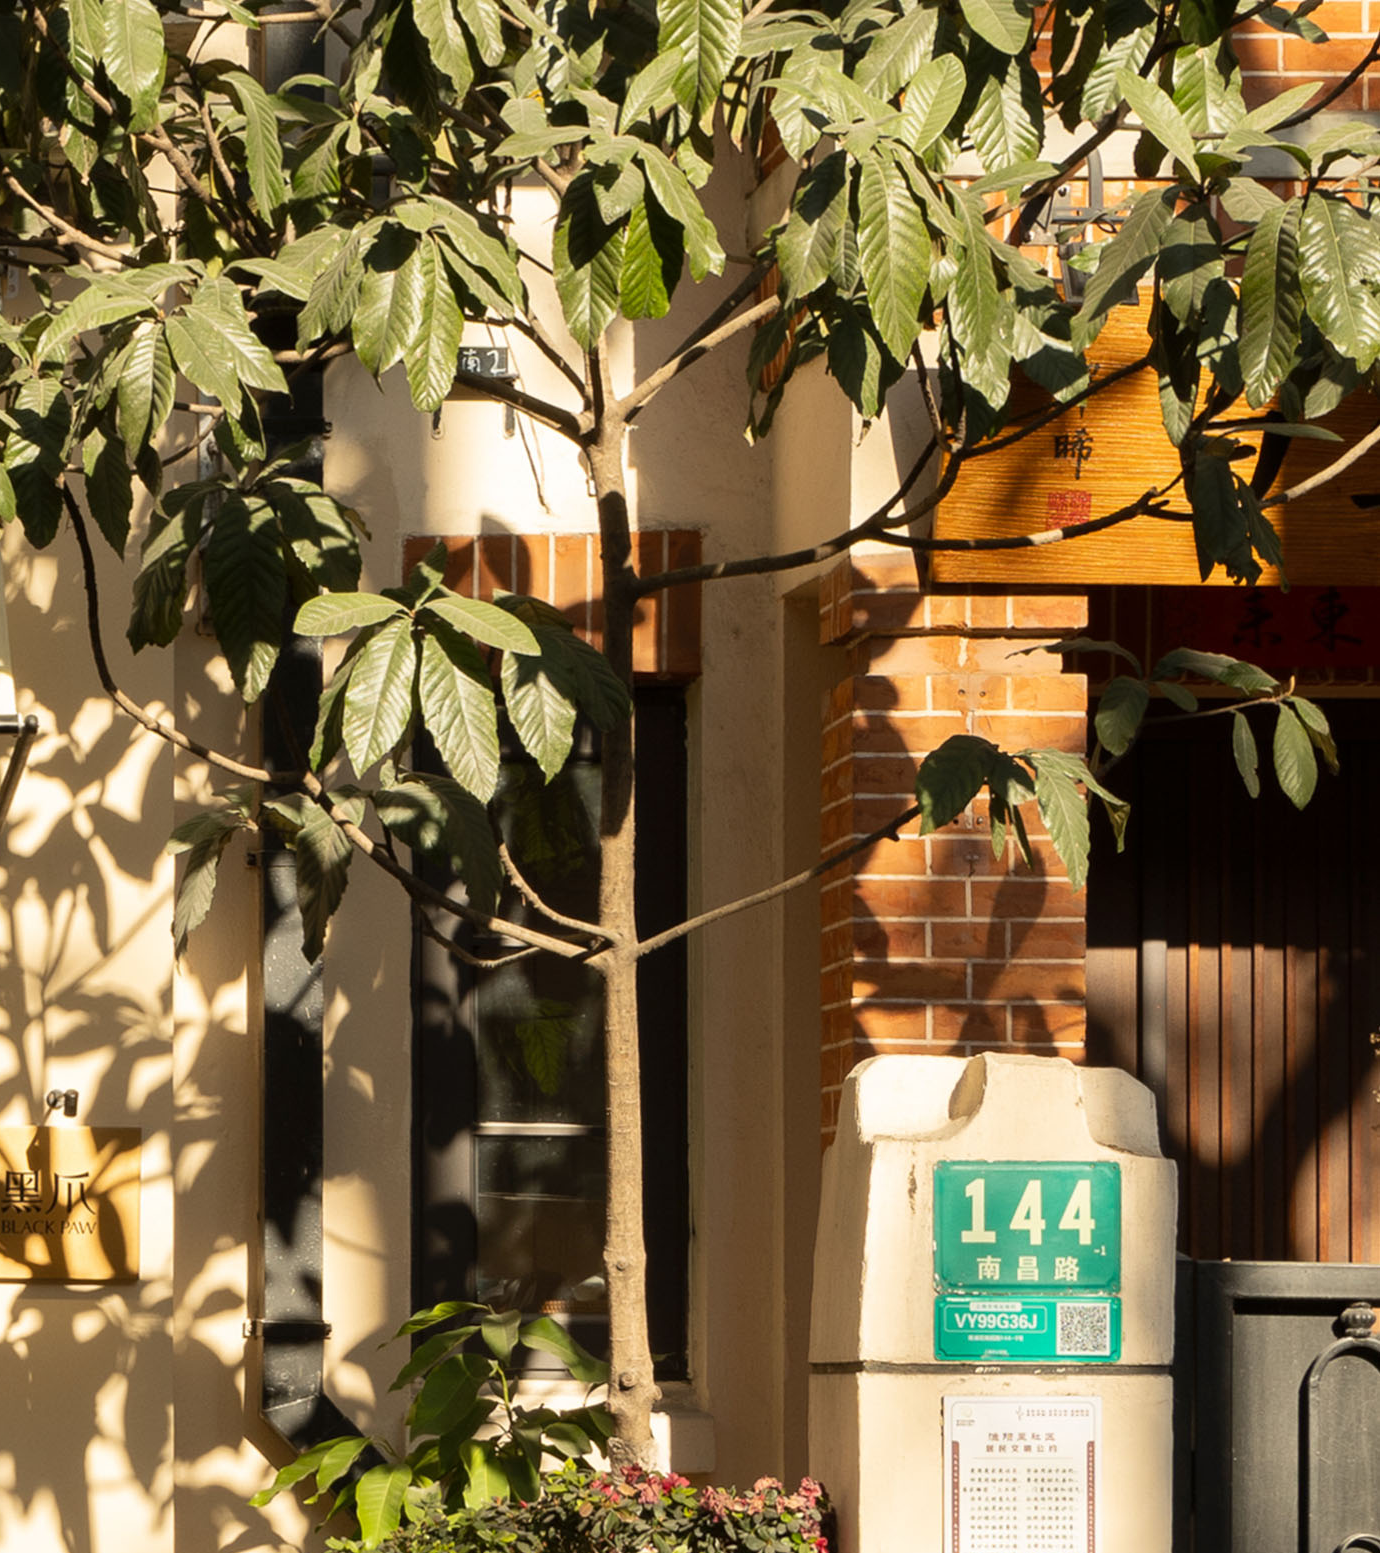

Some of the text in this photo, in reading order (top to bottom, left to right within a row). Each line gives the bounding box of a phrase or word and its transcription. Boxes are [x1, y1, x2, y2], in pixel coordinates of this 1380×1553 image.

[0, 1170, 96, 1215] 黑爪
[960, 1177, 1096, 1246] 144
[1, 1220, 97, 1235] BLACK PAW
[976, 1255, 1080, 1282] 南昌路
[954, 1313, 1038, 1330] VY99G36J
